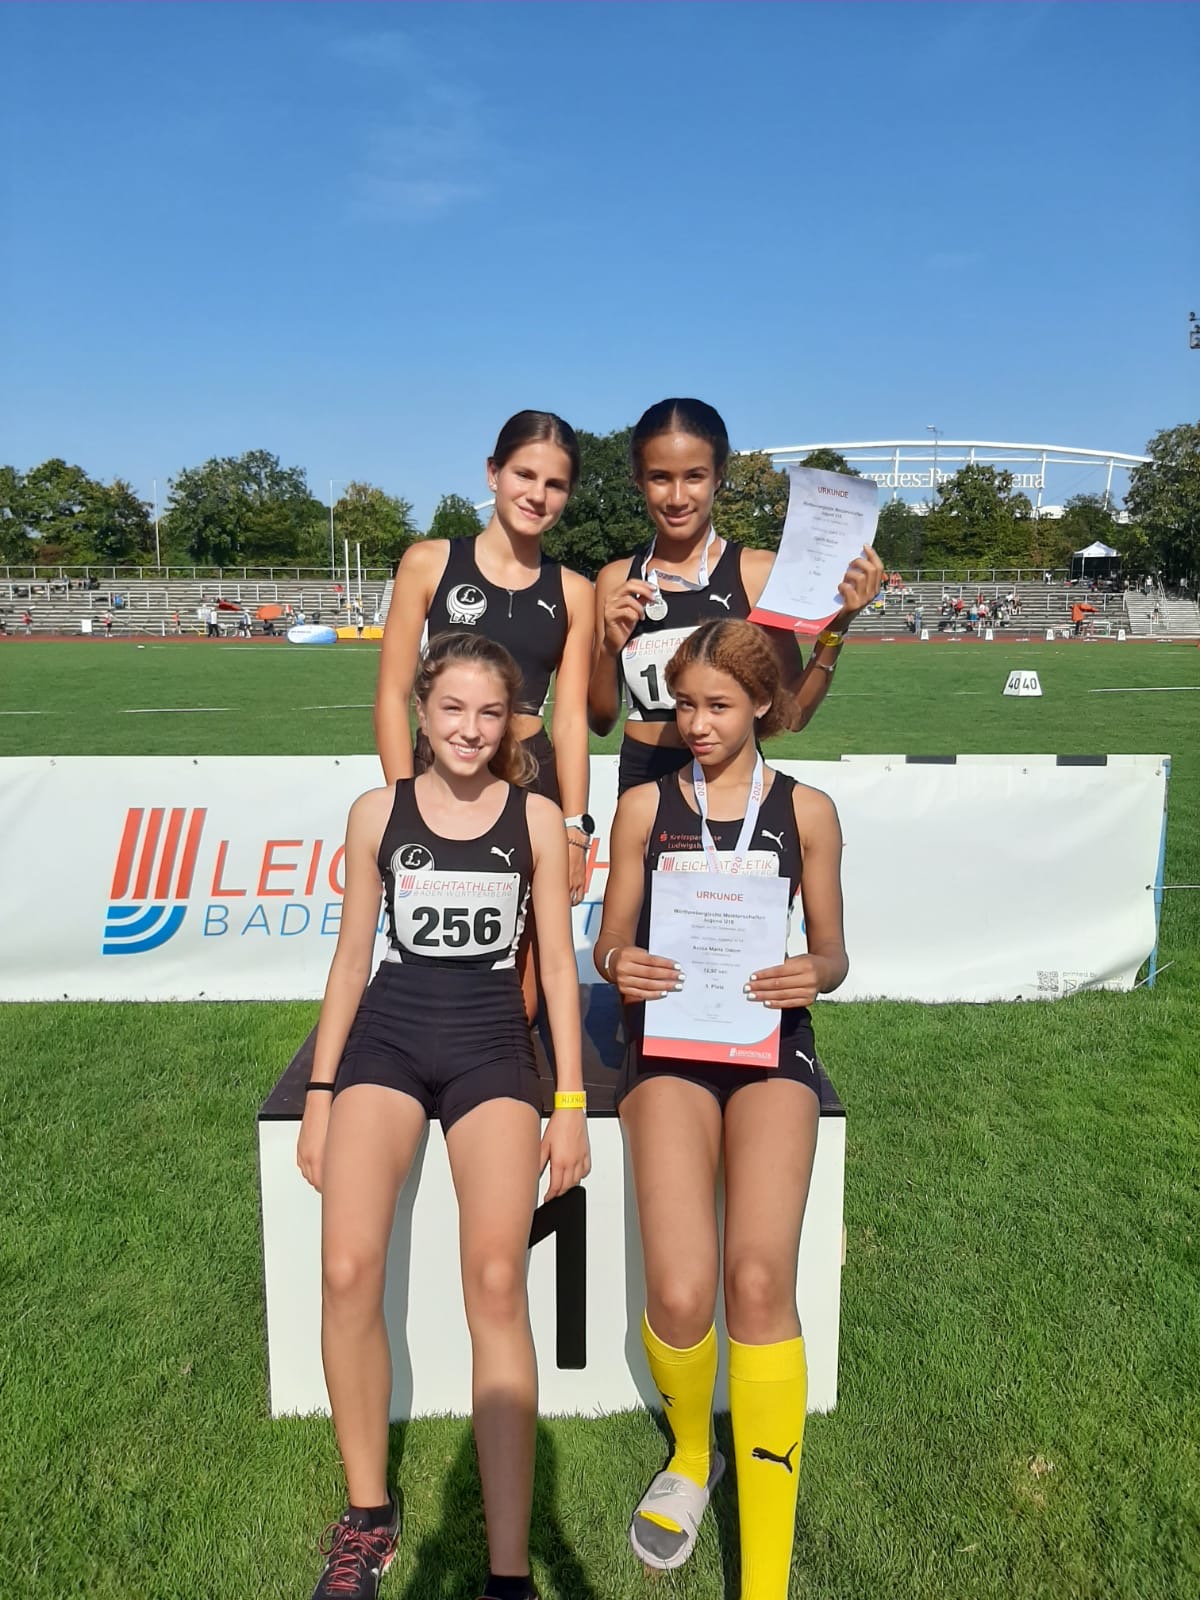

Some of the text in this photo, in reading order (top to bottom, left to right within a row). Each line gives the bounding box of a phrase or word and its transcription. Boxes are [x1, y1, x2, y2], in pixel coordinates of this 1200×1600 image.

[1011, 472, 1045, 488] ena
[449, 612, 476, 625] LAZ
[639, 637, 682, 650] LEICHTA
[640, 664, 660, 702] 1
[1008, 677, 1038, 690] 40 40
[669, 833, 722, 842] Kreissparse
[667, 842, 702, 850] Ludwigsb
[211, 840, 346, 896] LEIC
[675, 859, 773, 872] LEICHATLETIK
[730, 856, 743, 875] 020
[415, 880, 513, 891] LEICHTATHLETIK
[696, 890, 745, 902] URKUNDE
[411, 906, 502, 948] 256
[527, 1185, 587, 1370] 1
